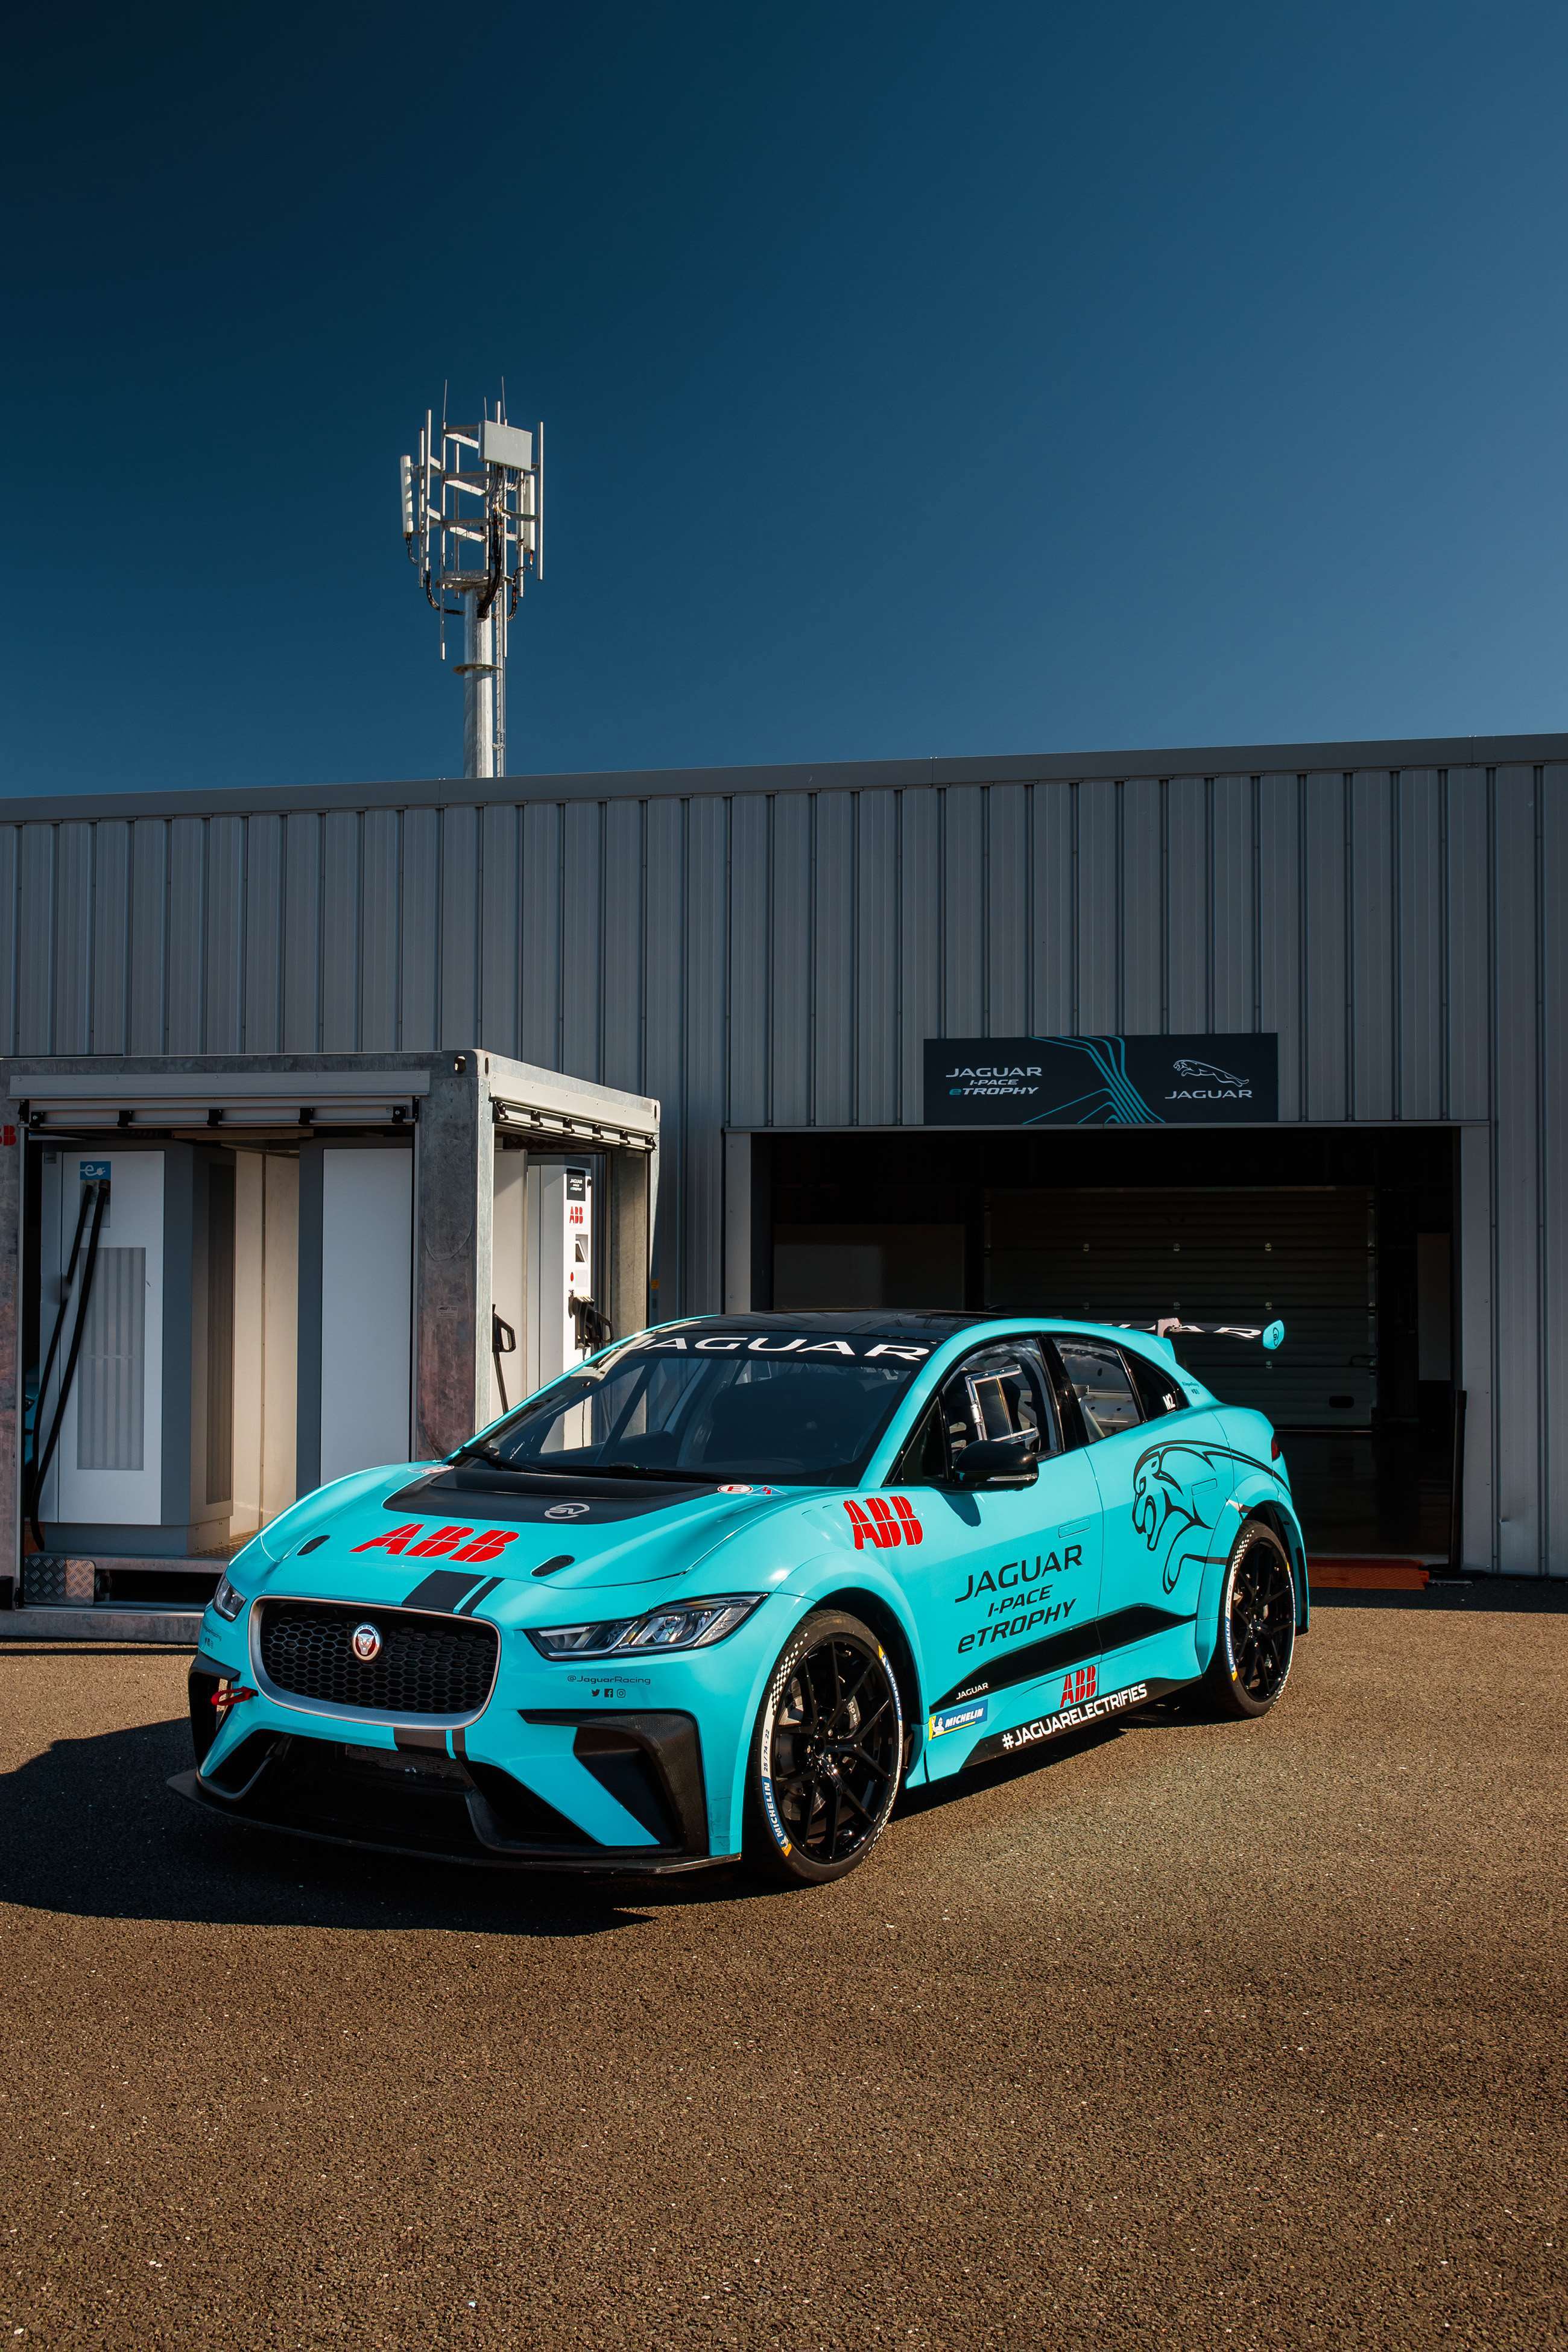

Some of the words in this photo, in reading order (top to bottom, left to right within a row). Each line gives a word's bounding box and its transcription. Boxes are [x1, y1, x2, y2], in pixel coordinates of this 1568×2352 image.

[946, 1067, 1042, 1077] JAGUAR
[949, 1087, 1038, 1095] eTROPHY
[1165, 1090, 1253, 1099] JAGUAR
[0, 1125, 16, 1146] B
[569, 1206, 583, 1224] ABB
[614, 1337, 929, 1361] JAGUAR
[843, 1496, 923, 1551] ABB
[349, 1523, 519, 1563] ABB
[955, 1544, 1083, 1604] JAGUAR
[987, 1584, 1053, 1617] I-PACE
[958, 1598, 1077, 1654] eTROPHY
[567, 1675, 651, 1685] @JaguarRacing
[886, 1664, 902, 1716] MICHELIN
[956, 1682, 989, 1700] JAGUAR
[1060, 1665, 1097, 1709] ABB
[944, 1708, 984, 1728] MICHELIN
[1002, 1683, 1148, 1750] #JAGUARELECTRIFIES
[764, 1782, 783, 1838] MICHELIN
